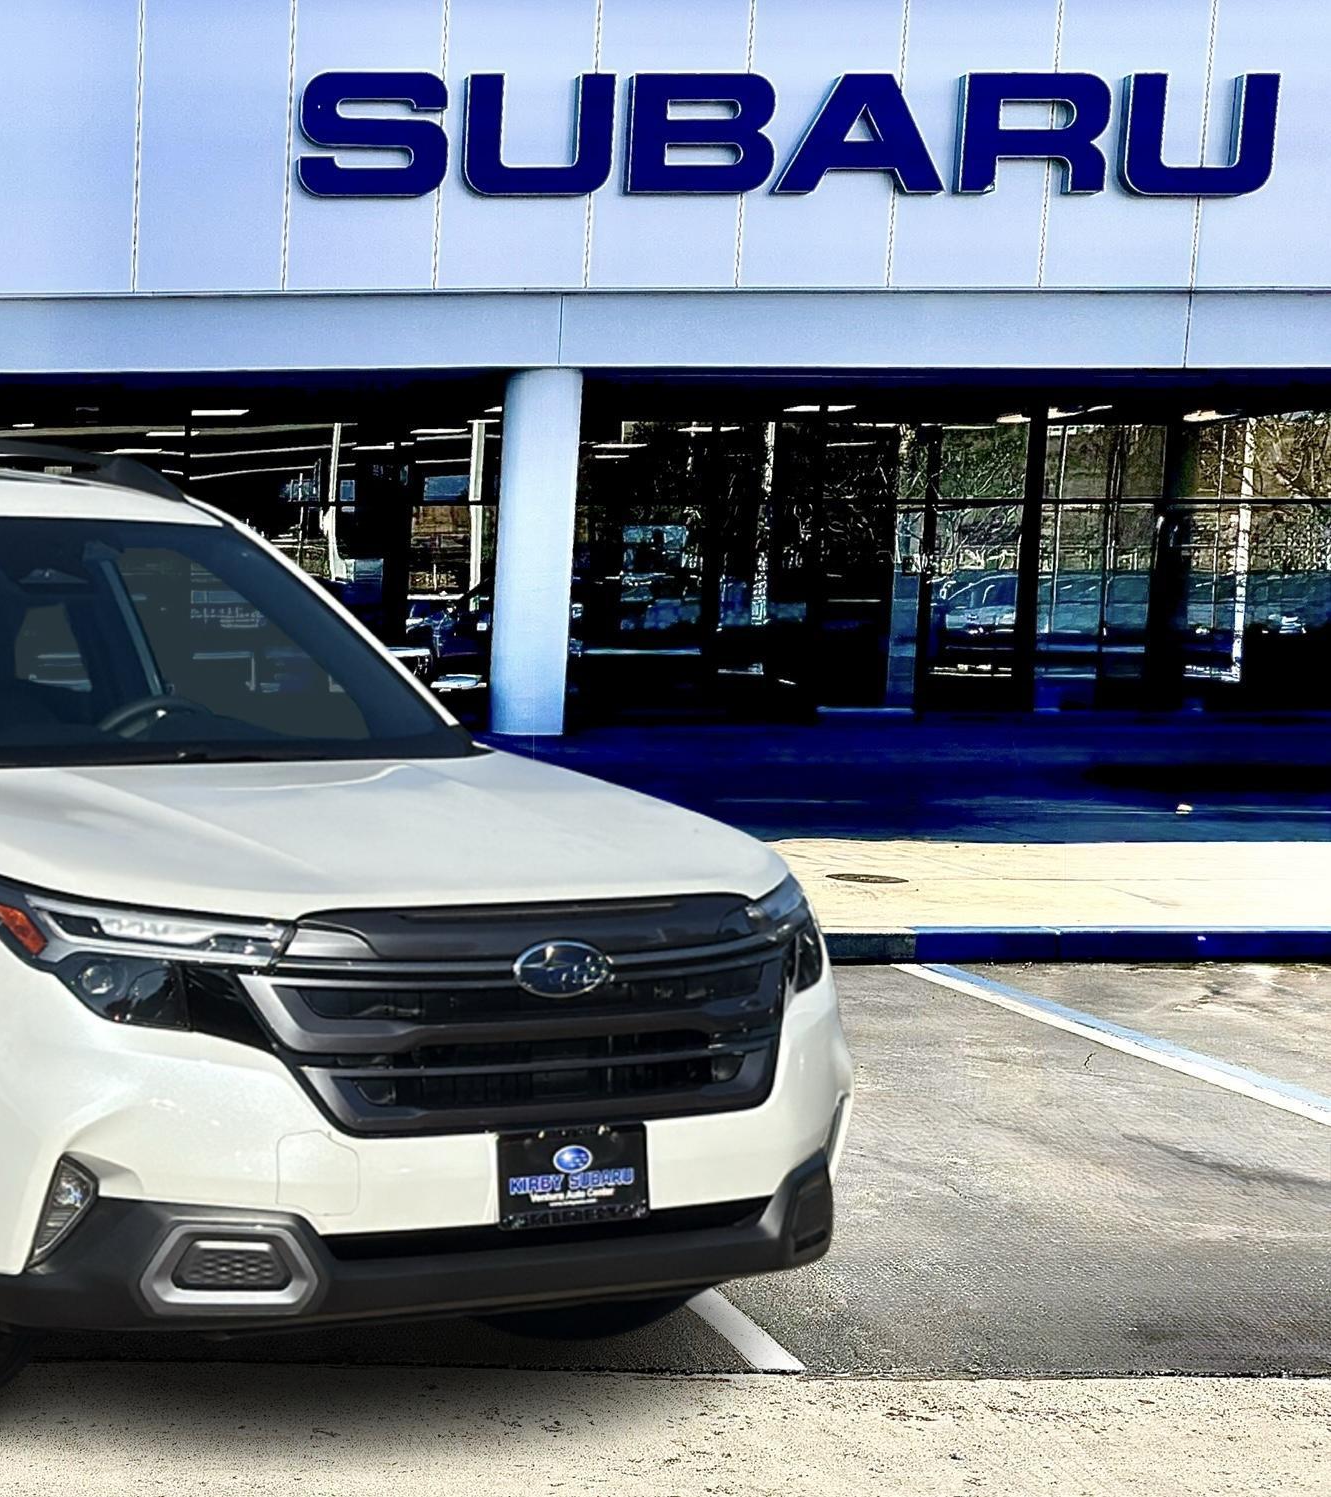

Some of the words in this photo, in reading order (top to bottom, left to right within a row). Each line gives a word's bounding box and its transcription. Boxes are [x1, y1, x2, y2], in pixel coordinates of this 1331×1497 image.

[298, 71, 1280, 197] SUBARU
[509, 1174, 564, 1195] KIRBY
[568, 1168, 634, 1190] SUBARU
[529, 1190, 565, 1203] Ventura
[565, 1189, 586, 1200] Auto
[586, 1187, 616, 1198] Center
